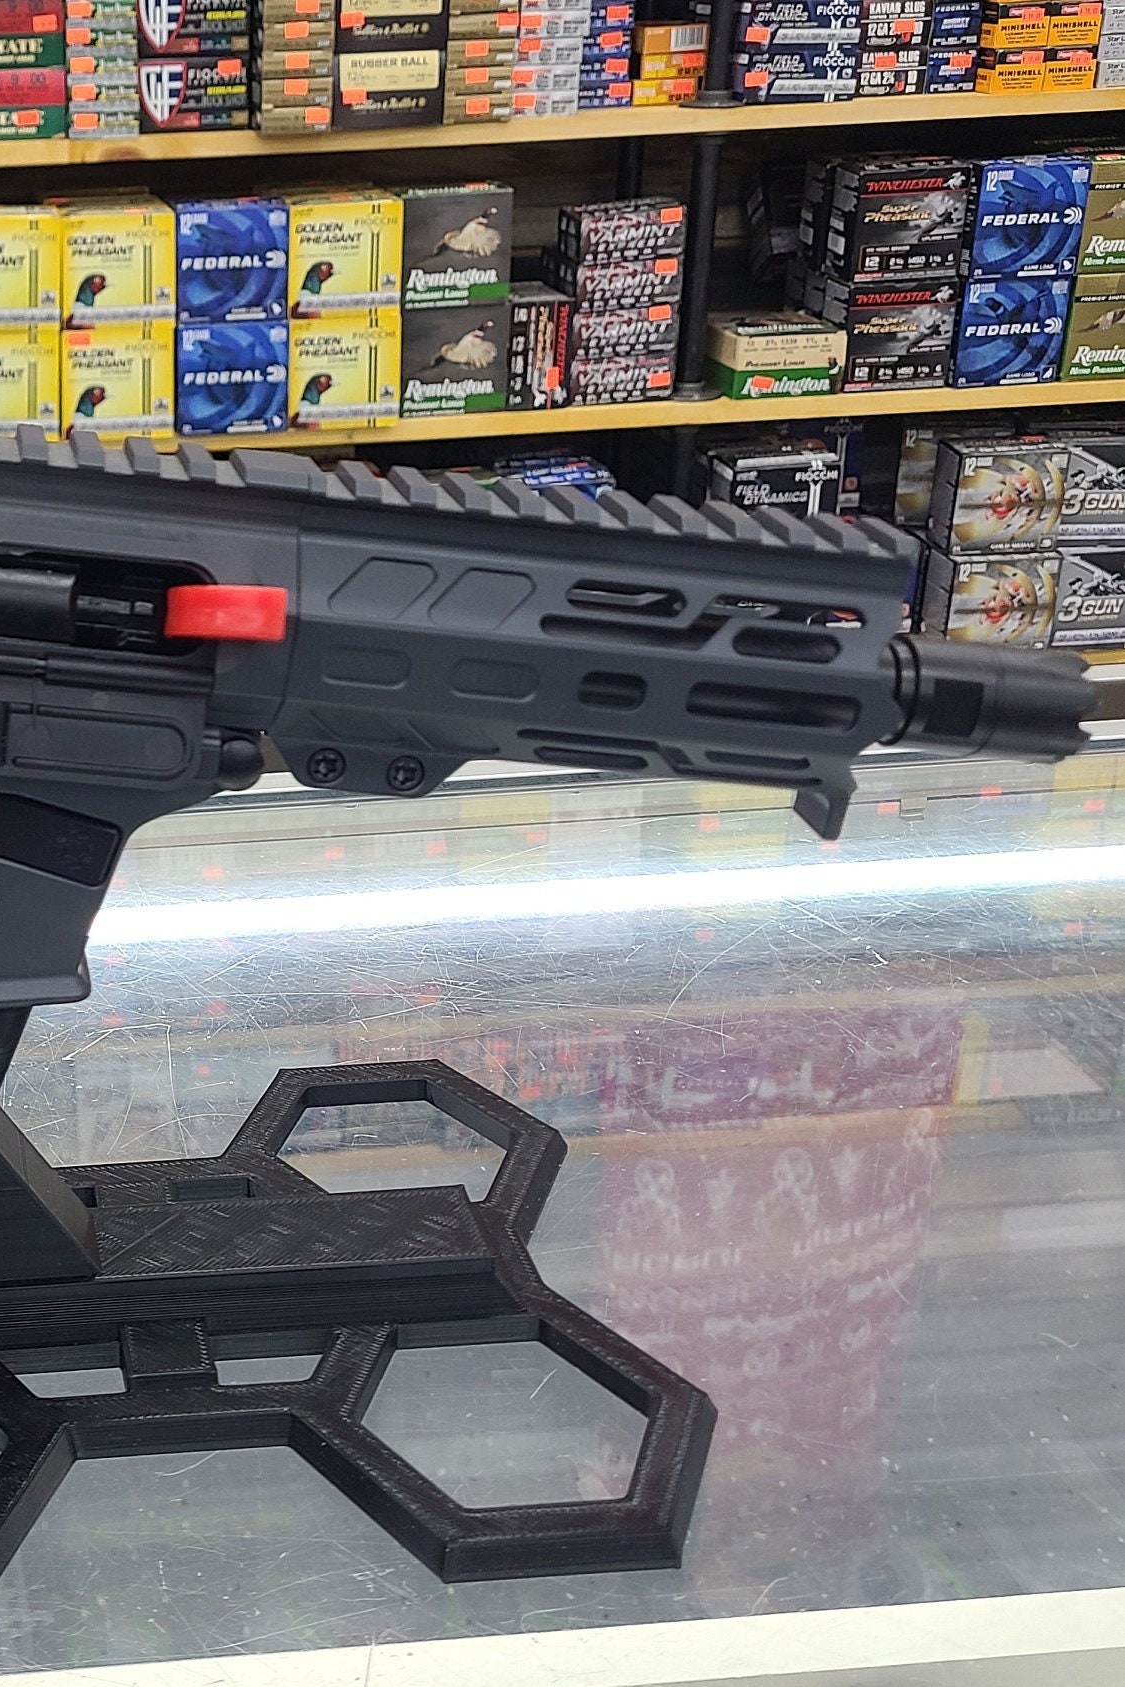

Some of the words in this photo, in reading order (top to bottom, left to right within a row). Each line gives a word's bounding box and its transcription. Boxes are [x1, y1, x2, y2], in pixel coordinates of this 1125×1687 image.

[776, 4, 804, 14] FIELD
[816, 5, 860, 16] FIOCCHI
[869, 1, 901, 15] KAVIAR
[904, 1, 926, 13] SLUG
[757, 12, 809, 21] DYNAMICS
[867, 23, 876, 36] 12
[1001, 22, 1046, 31] MINISHELL
[1053, 20, 1098, 29] MINISHELL
[351, 58, 397, 68] RUBBER
[401, 57, 428, 66] BALL
[772, 55, 800, 66] FIELD
[812, 56, 856, 67] FIOCCHI
[898, 50, 920, 62] SLUG
[998, 69, 1042, 77] MINISHELL
[1048, 65, 1093, 74] MINISHELL
[860, 72, 870, 85] 12
[865, 177, 945, 192] WINCHESTER
[985, 170, 998, 192] 12
[880, 204, 918, 213] Super
[864, 210, 931, 222] Pheasant
[982, 213, 1060, 227] FEDERAL
[295, 221, 343, 234] GOLDEN
[590, 223, 681, 244] VARMINT
[299, 233, 362, 245] PHEASANT
[181, 255, 263, 271] FEDERAL
[865, 256, 880, 267] 12
[406, 267, 499, 291] Remington
[586, 273, 673, 292] VARMINT
[855, 291, 932, 305] WINCHESTER
[969, 283, 980, 304] 12
[869, 316, 906, 325] Super
[580, 319, 673, 340] VARMINT
[854, 323, 920, 335] Pheasant
[965, 323, 1041, 337] FEDERAL
[299, 346, 360, 357] PHEASANT
[184, 369, 264, 385] FEDERAL
[855, 366, 869, 378] 12
[403, 378, 494, 401] Remington
[906, 430, 917, 447] 12
[964, 457, 977, 476] 12
[795, 469, 838, 482] FIOCCHI
[735, 484, 770, 497] FIELD
[743, 490, 808, 505] DYNAMICS
[1061, 488, 1085, 515] 3
[958, 563, 971, 582] 12
[1058, 595, 1083, 622] 3
[1081, 598, 1123, 616] GUN
